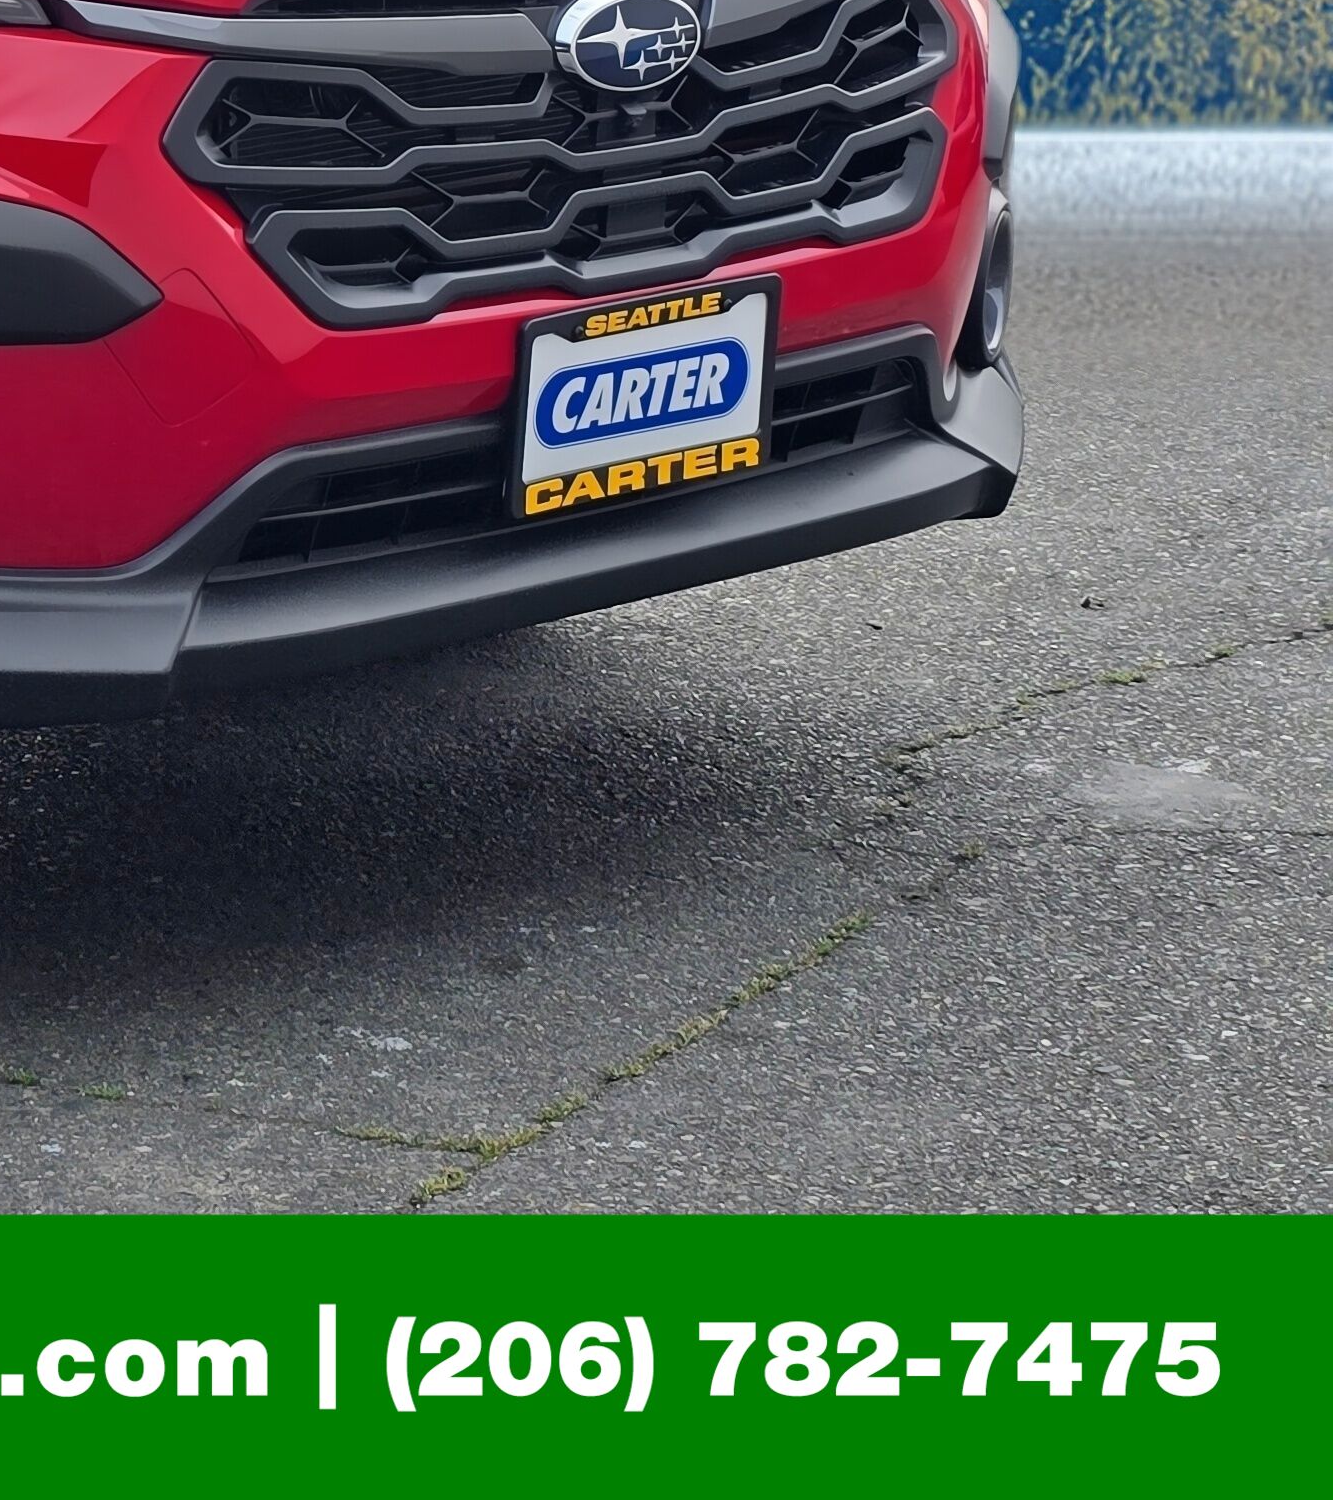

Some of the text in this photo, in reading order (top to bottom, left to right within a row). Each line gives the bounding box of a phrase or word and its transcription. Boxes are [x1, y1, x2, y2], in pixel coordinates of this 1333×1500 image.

[584, 291, 722, 338] SEATTLE
[551, 352, 730, 434] CARTER
[525, 437, 761, 516] CARTER
